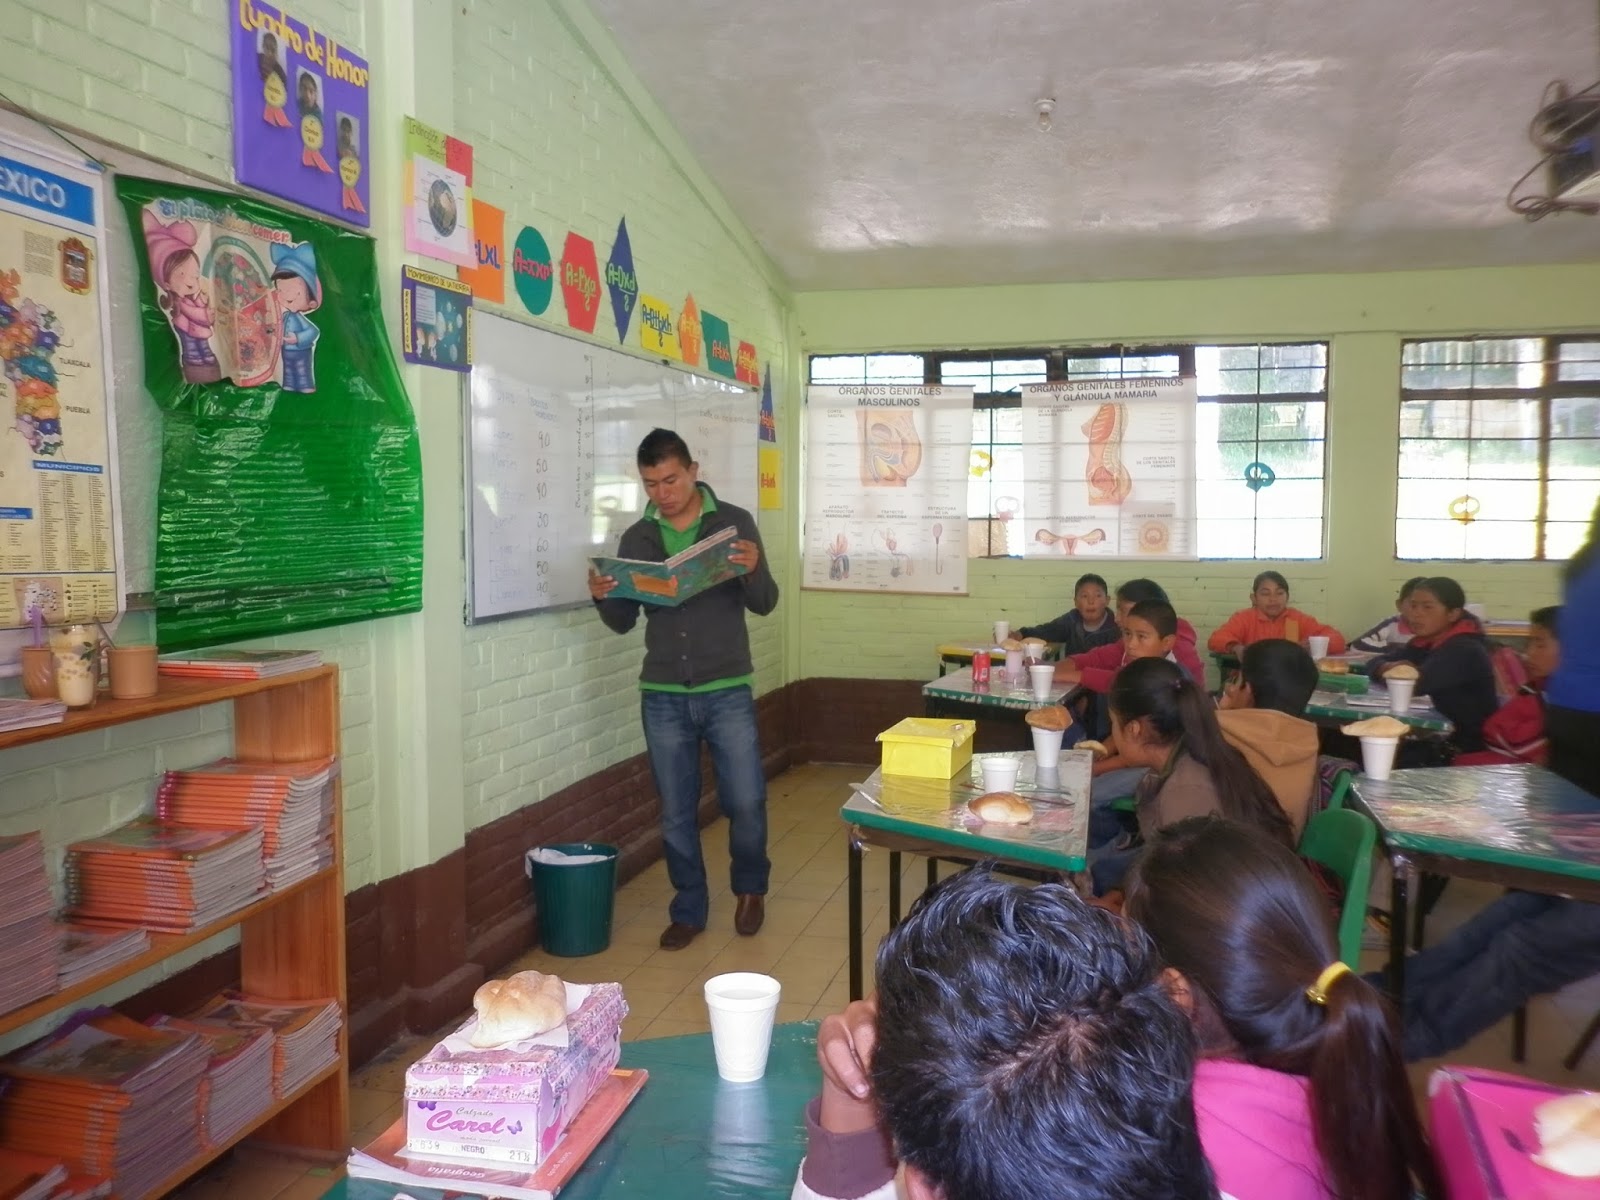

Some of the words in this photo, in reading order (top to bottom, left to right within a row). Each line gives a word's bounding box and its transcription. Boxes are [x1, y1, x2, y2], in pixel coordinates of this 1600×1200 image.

[240, 0, 302, 54] Cuadro
[305, 25, 324, 66] de
[326, 36, 369, 88] Honor
[252, 225, 290, 242] comer
[59, 357, 92, 369] TLAXCALA
[889, 385, 942, 396] GENITALES
[1077, 381, 1126, 392] GENITALES
[1129, 378, 1184, 389] FEMENINOS
[1054, 394, 1060, 402] Y
[1114, 389, 1158, 399] MAMARIA
[857, 397, 920, 407] MASCULINOS
[65, 404, 91, 415] PUEBLA
[36, 461, 101, 473] MUNICIPIOS
[536, 537, 549, 552] 60
[456, 1107, 493, 1116] Calzado
[427, 1110, 505, 1134] Carol
[461, 1145, 485, 1155] NEGRO
